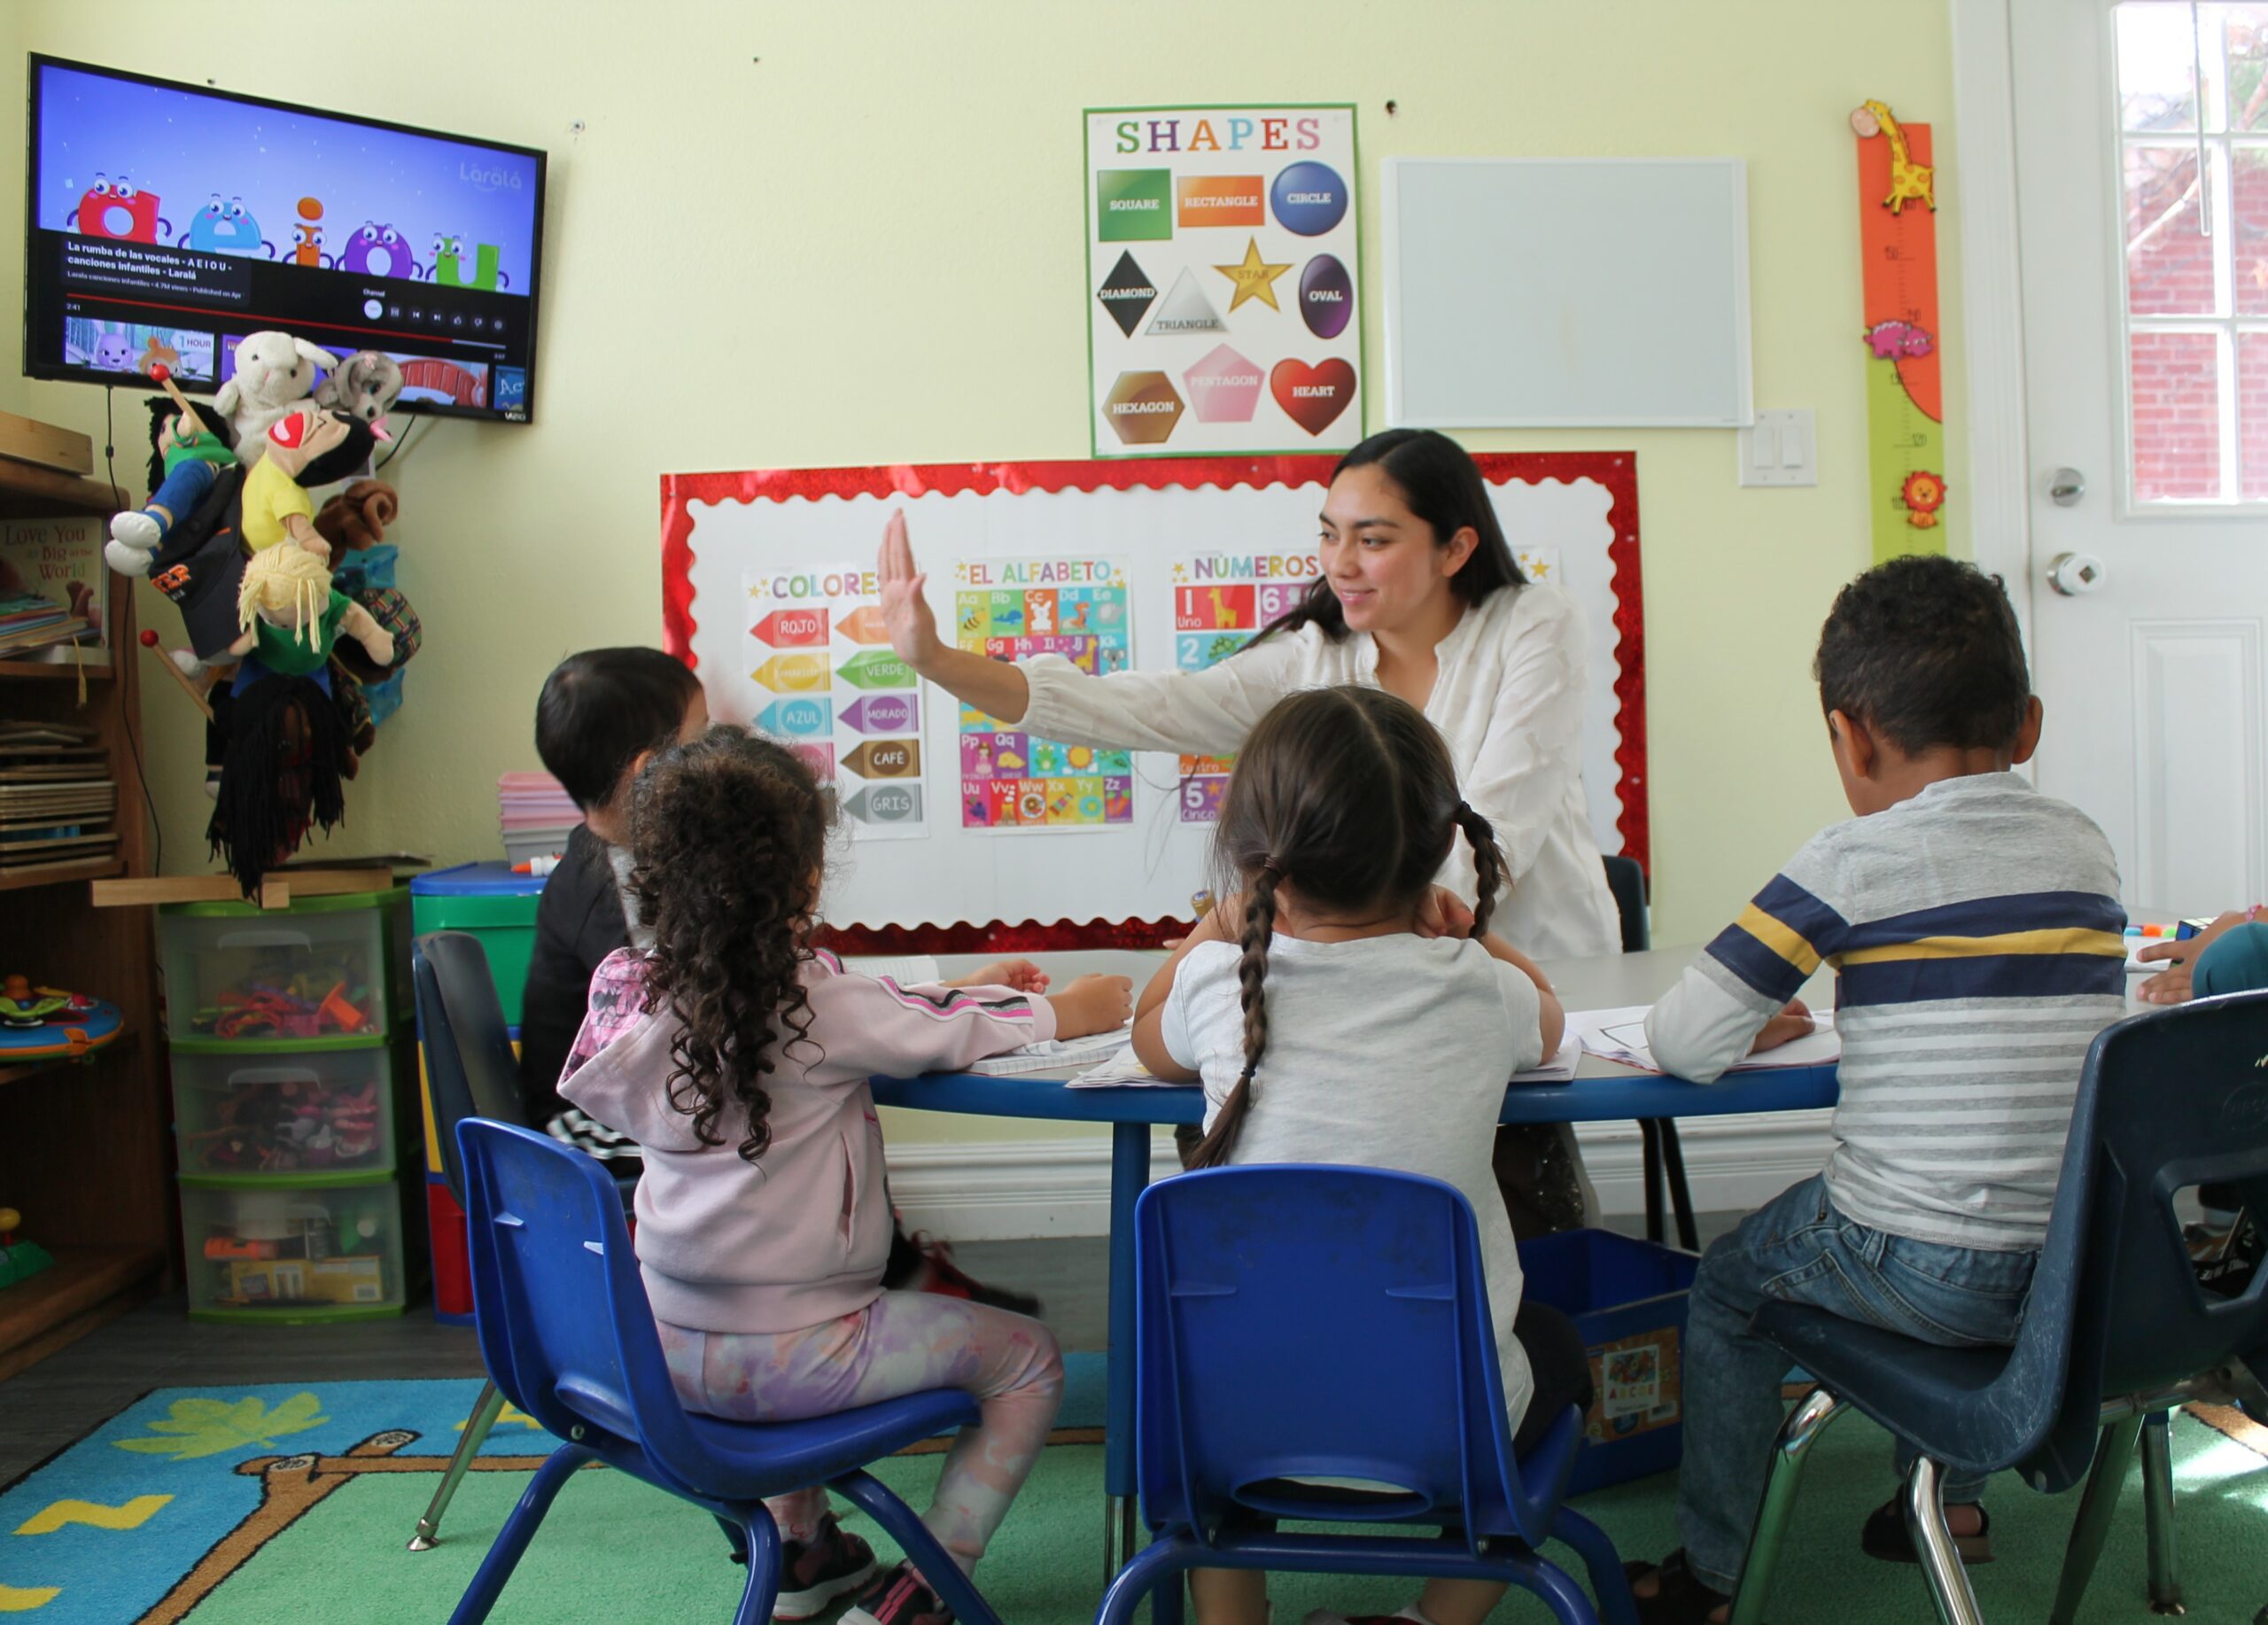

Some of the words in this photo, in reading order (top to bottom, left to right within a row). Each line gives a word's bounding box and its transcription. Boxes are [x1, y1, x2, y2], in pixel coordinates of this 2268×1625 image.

[1116, 117, 1320, 153] SHAPES
[1109, 198, 1160, 211] SQUARE
[1184, 196, 1258, 208] RECTANGLE
[1287, 192, 1332, 205] CIRCLE
[68, 241, 81, 252] La
[82, 244, 113, 256] rumba
[115, 246, 128, 258] de
[129, 249, 144, 260] las
[145, 251, 180, 265] vocales
[188, 259, 195, 268] A
[197, 259, 203, 268] E
[210, 261, 217, 270] O
[220, 262, 226, 271] U
[67, 255, 117, 269] canciones
[118, 261, 160, 276] infantiles
[168, 268, 197, 281] Laralá
[1239, 268, 1270, 280] STAR
[1099, 288, 1155, 300] DIAMOND
[1309, 290, 1343, 302] OVAL
[1157, 318, 1219, 330] TRIANGLE
[187, 338, 211, 348] HOUR
[1190, 375, 1259, 387] PENTAGON
[1293, 385, 1335, 397] HEART
[1113, 401, 1175, 415] HEXAGON
[5, 525, 48, 546] Love
[55, 525, 86, 544] You
[43, 546, 67, 562] Big
[39, 562, 86, 580] World
[969, 564, 993, 585] EL
[1002, 561, 1111, 583] ALFABETO
[1194, 554, 1319, 579] NÚMEROS
[773, 571, 881, 599] COLORE
[959, 593, 978, 604] Aa
[990, 592, 1011, 603] Bb
[1025, 590, 1044, 603] Cc
[1059, 589, 1079, 601] Dd
[1092, 588, 1112, 601] Ee
[1262, 587, 1281, 612] 6
[1184, 588, 1192, 615] 1
[780, 619, 816, 635] ROJO
[1177, 617, 1202, 628] Uno
[986, 638, 1005, 653] Gg
[1014, 638, 1032, 651] Hh
[1181, 638, 1200, 664] 2
[866, 662, 905, 677] VERDE
[786, 710, 819, 724] AZUL
[866, 708, 908, 720] MORADO
[961, 734, 979, 749] Pp
[995, 734, 1015, 747] Qq
[963, 782, 980, 794] Uu
[990, 781, 1008, 793] Vv
[1019, 781, 1044, 793] Ww
[1047, 780, 1066, 791] Xx
[1077, 779, 1094, 792] Yy
[1105, 778, 1121, 790] Zz
[1185, 781, 1205, 808] 5
[873, 796, 911, 812] GRIS
[1182, 808, 1216, 820] Cinco
